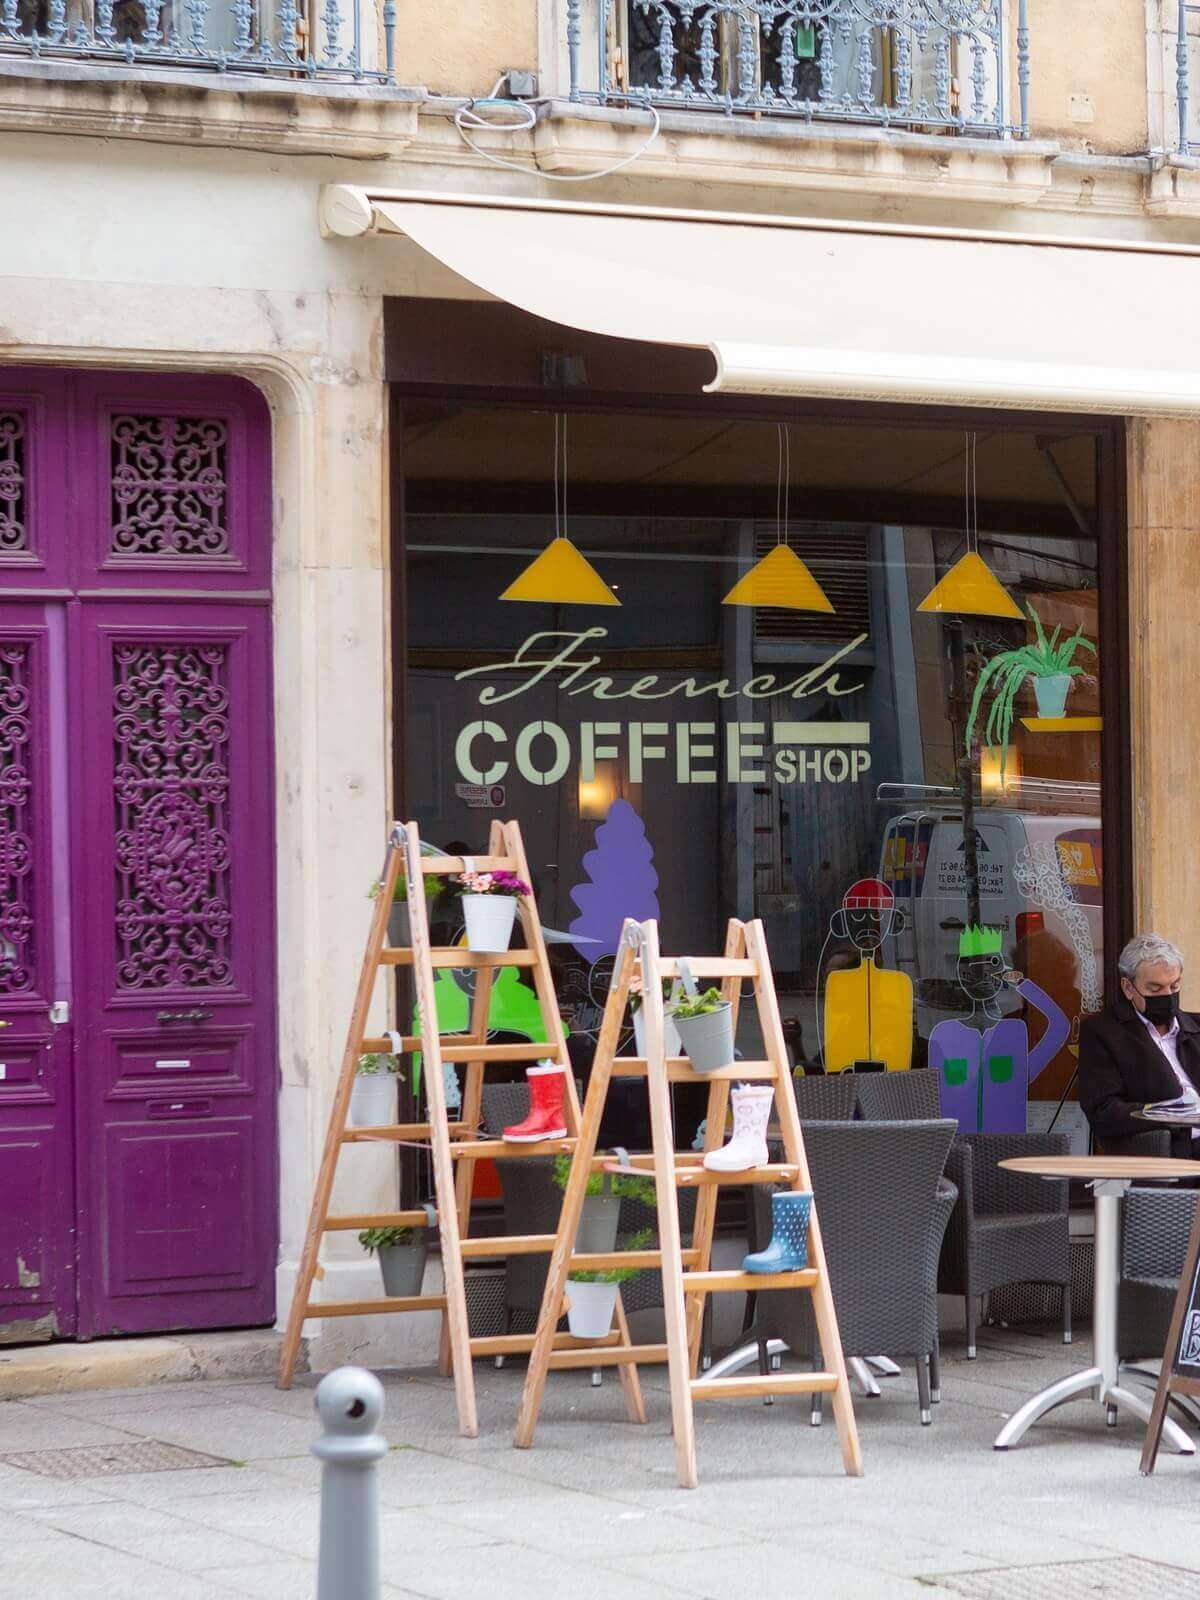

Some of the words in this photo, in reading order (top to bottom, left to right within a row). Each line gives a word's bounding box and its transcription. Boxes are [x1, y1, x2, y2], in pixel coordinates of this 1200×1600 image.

[454, 626, 869, 705] French
[455, 719, 768, 785] COFFEE
[773, 749, 872, 784] SHOP
